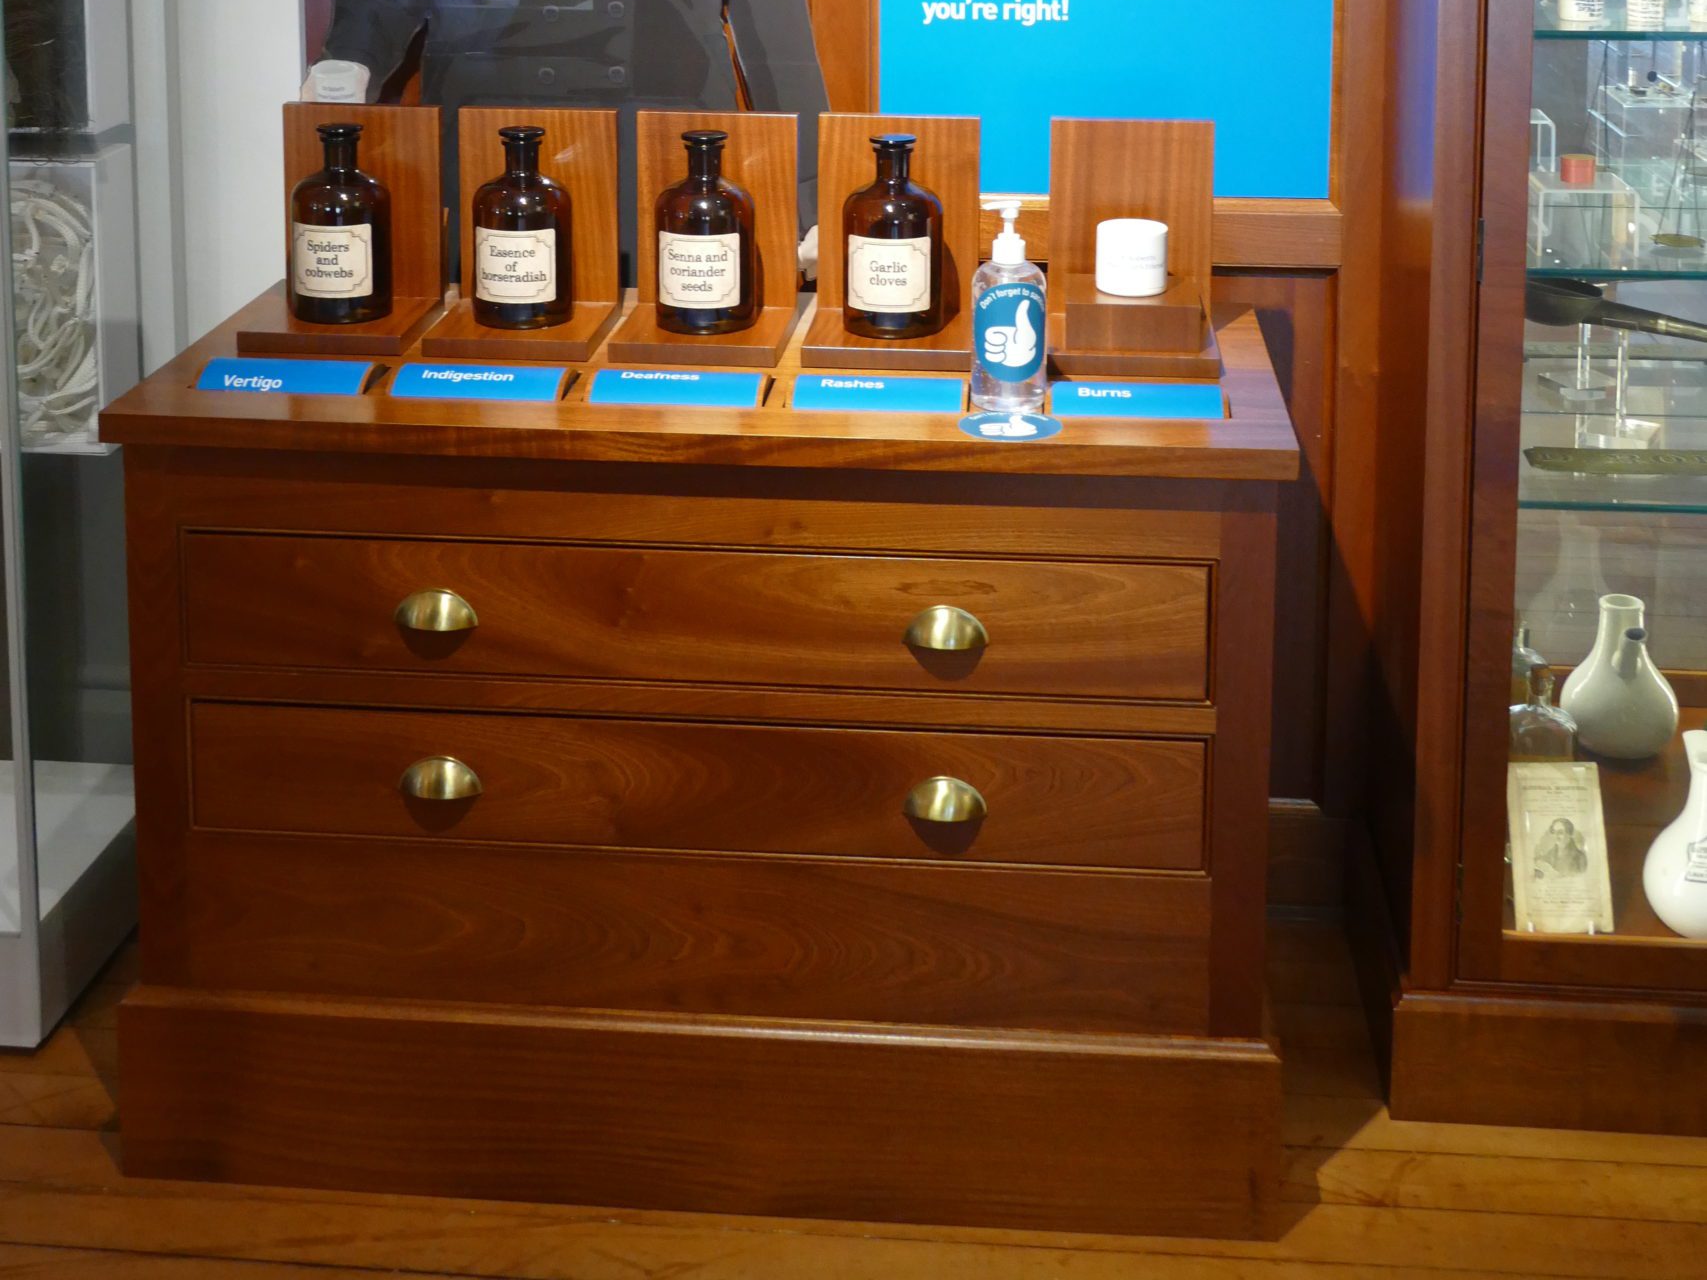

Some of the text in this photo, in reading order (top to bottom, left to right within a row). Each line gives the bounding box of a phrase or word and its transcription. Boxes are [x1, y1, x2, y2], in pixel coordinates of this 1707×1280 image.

[307, 240, 349, 254] Spiders
[489, 245, 536, 258] Essence
[316, 255, 339, 265] and
[667, 248, 728, 262] Senna and
[505, 261, 518, 272] of
[670, 266, 726, 277] coriander
[870, 260, 908, 272] Garlic
[305, 267, 354, 278] cobwebs
[481, 268, 546, 282] horseradish
[681, 281, 713, 291] seeds
[869, 274, 908, 286] cloves
[996, 288, 1021, 297] forget
[1022, 288, 1030, 296] to
[421, 369, 515, 382] Indigestion
[620, 371, 700, 381] Deafness
[223, 374, 283, 392] Vertigo
[821, 378, 885, 390] Rashes
[1077, 387, 1132, 398] Burns
